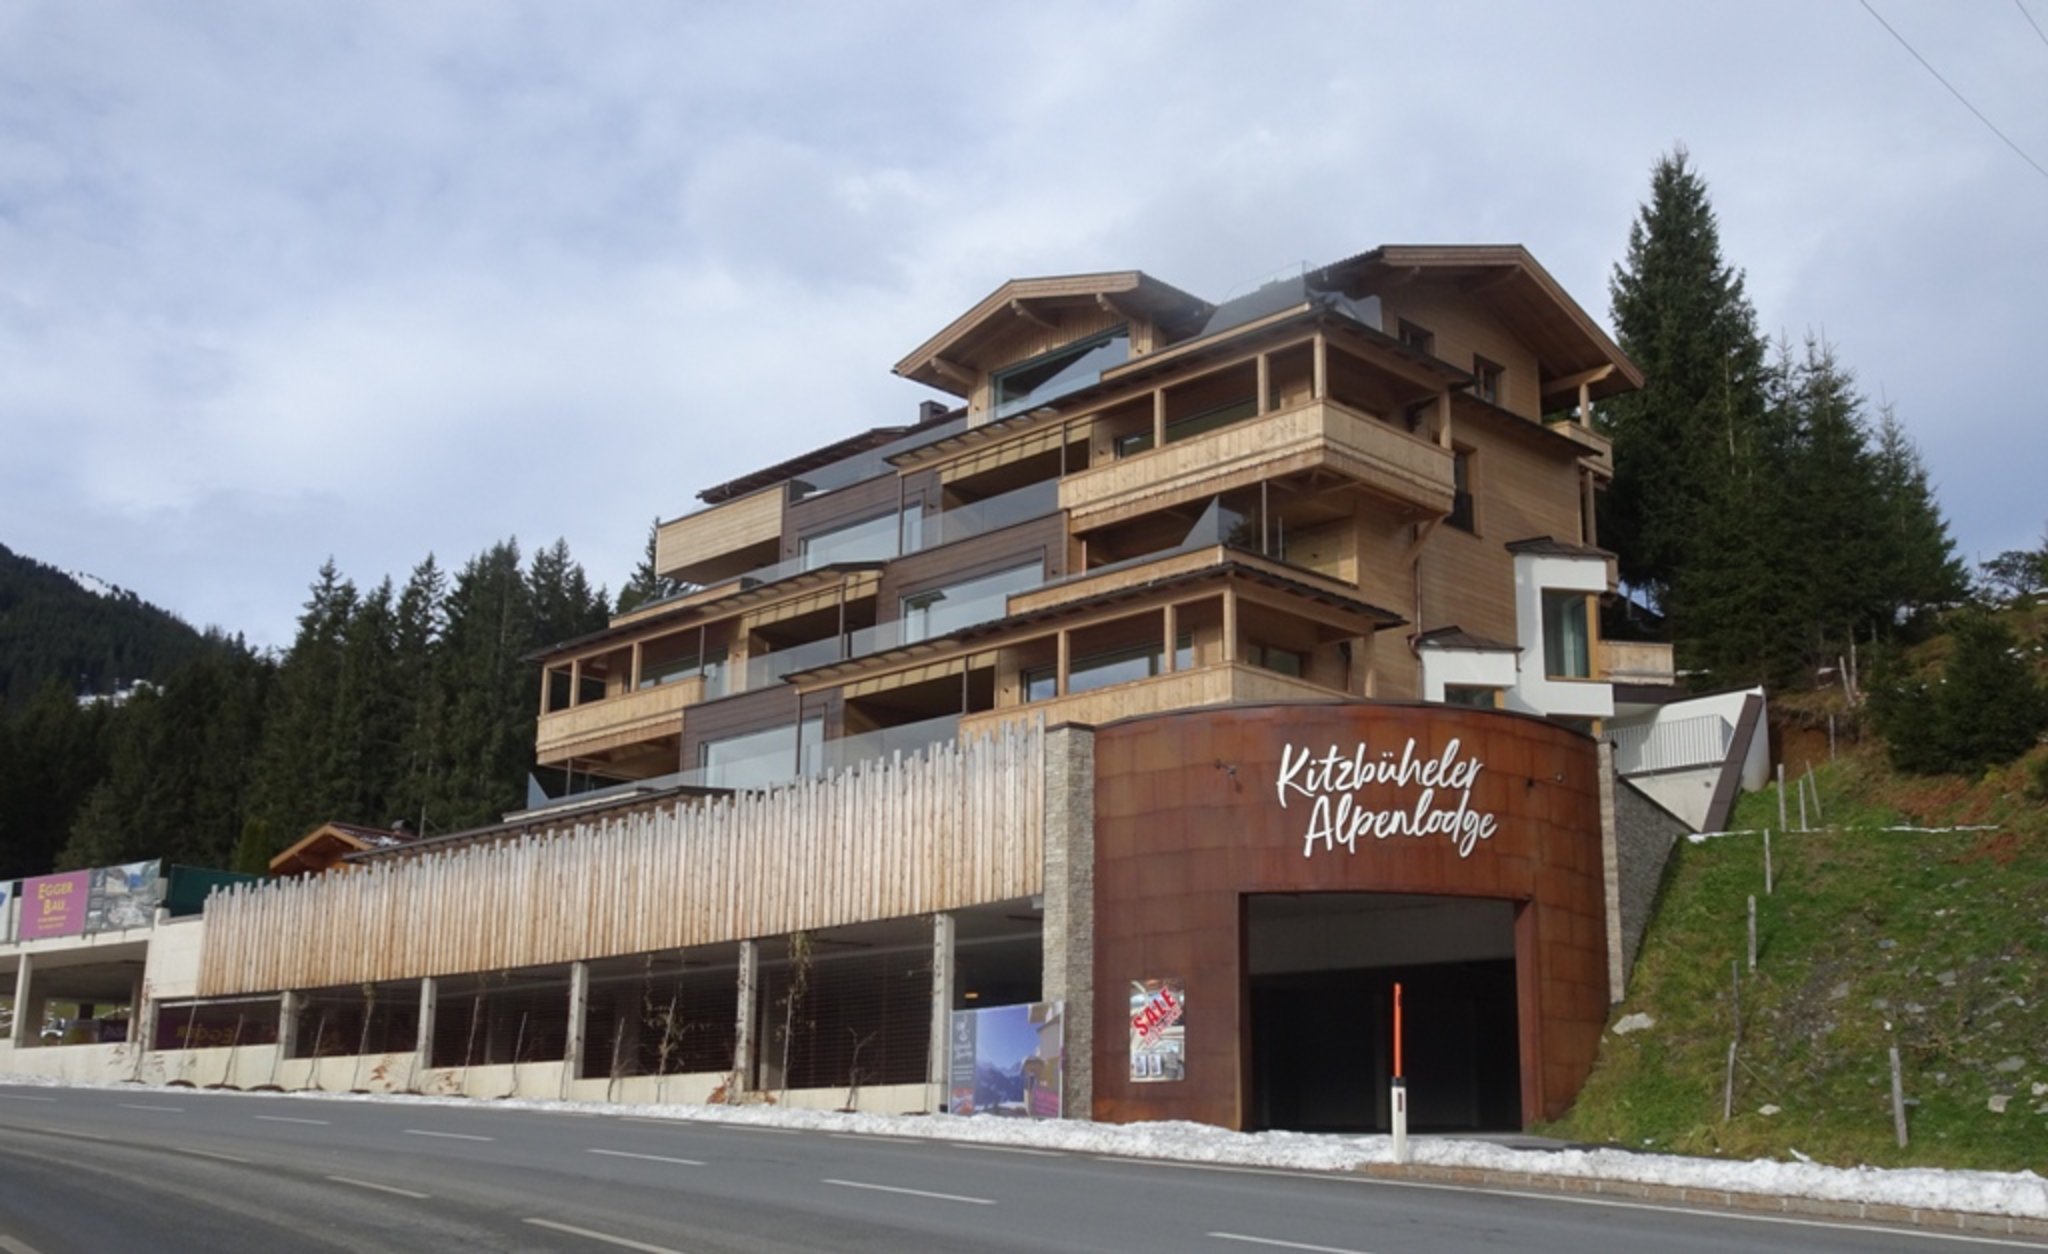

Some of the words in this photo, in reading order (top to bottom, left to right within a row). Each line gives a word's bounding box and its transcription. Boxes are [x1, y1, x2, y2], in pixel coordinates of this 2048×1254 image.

[1276, 737, 1484, 808] Kitzbüheler
[1303, 788, 1498, 858] Alpenlodge
[1133, 986, 1177, 1037] SALE
